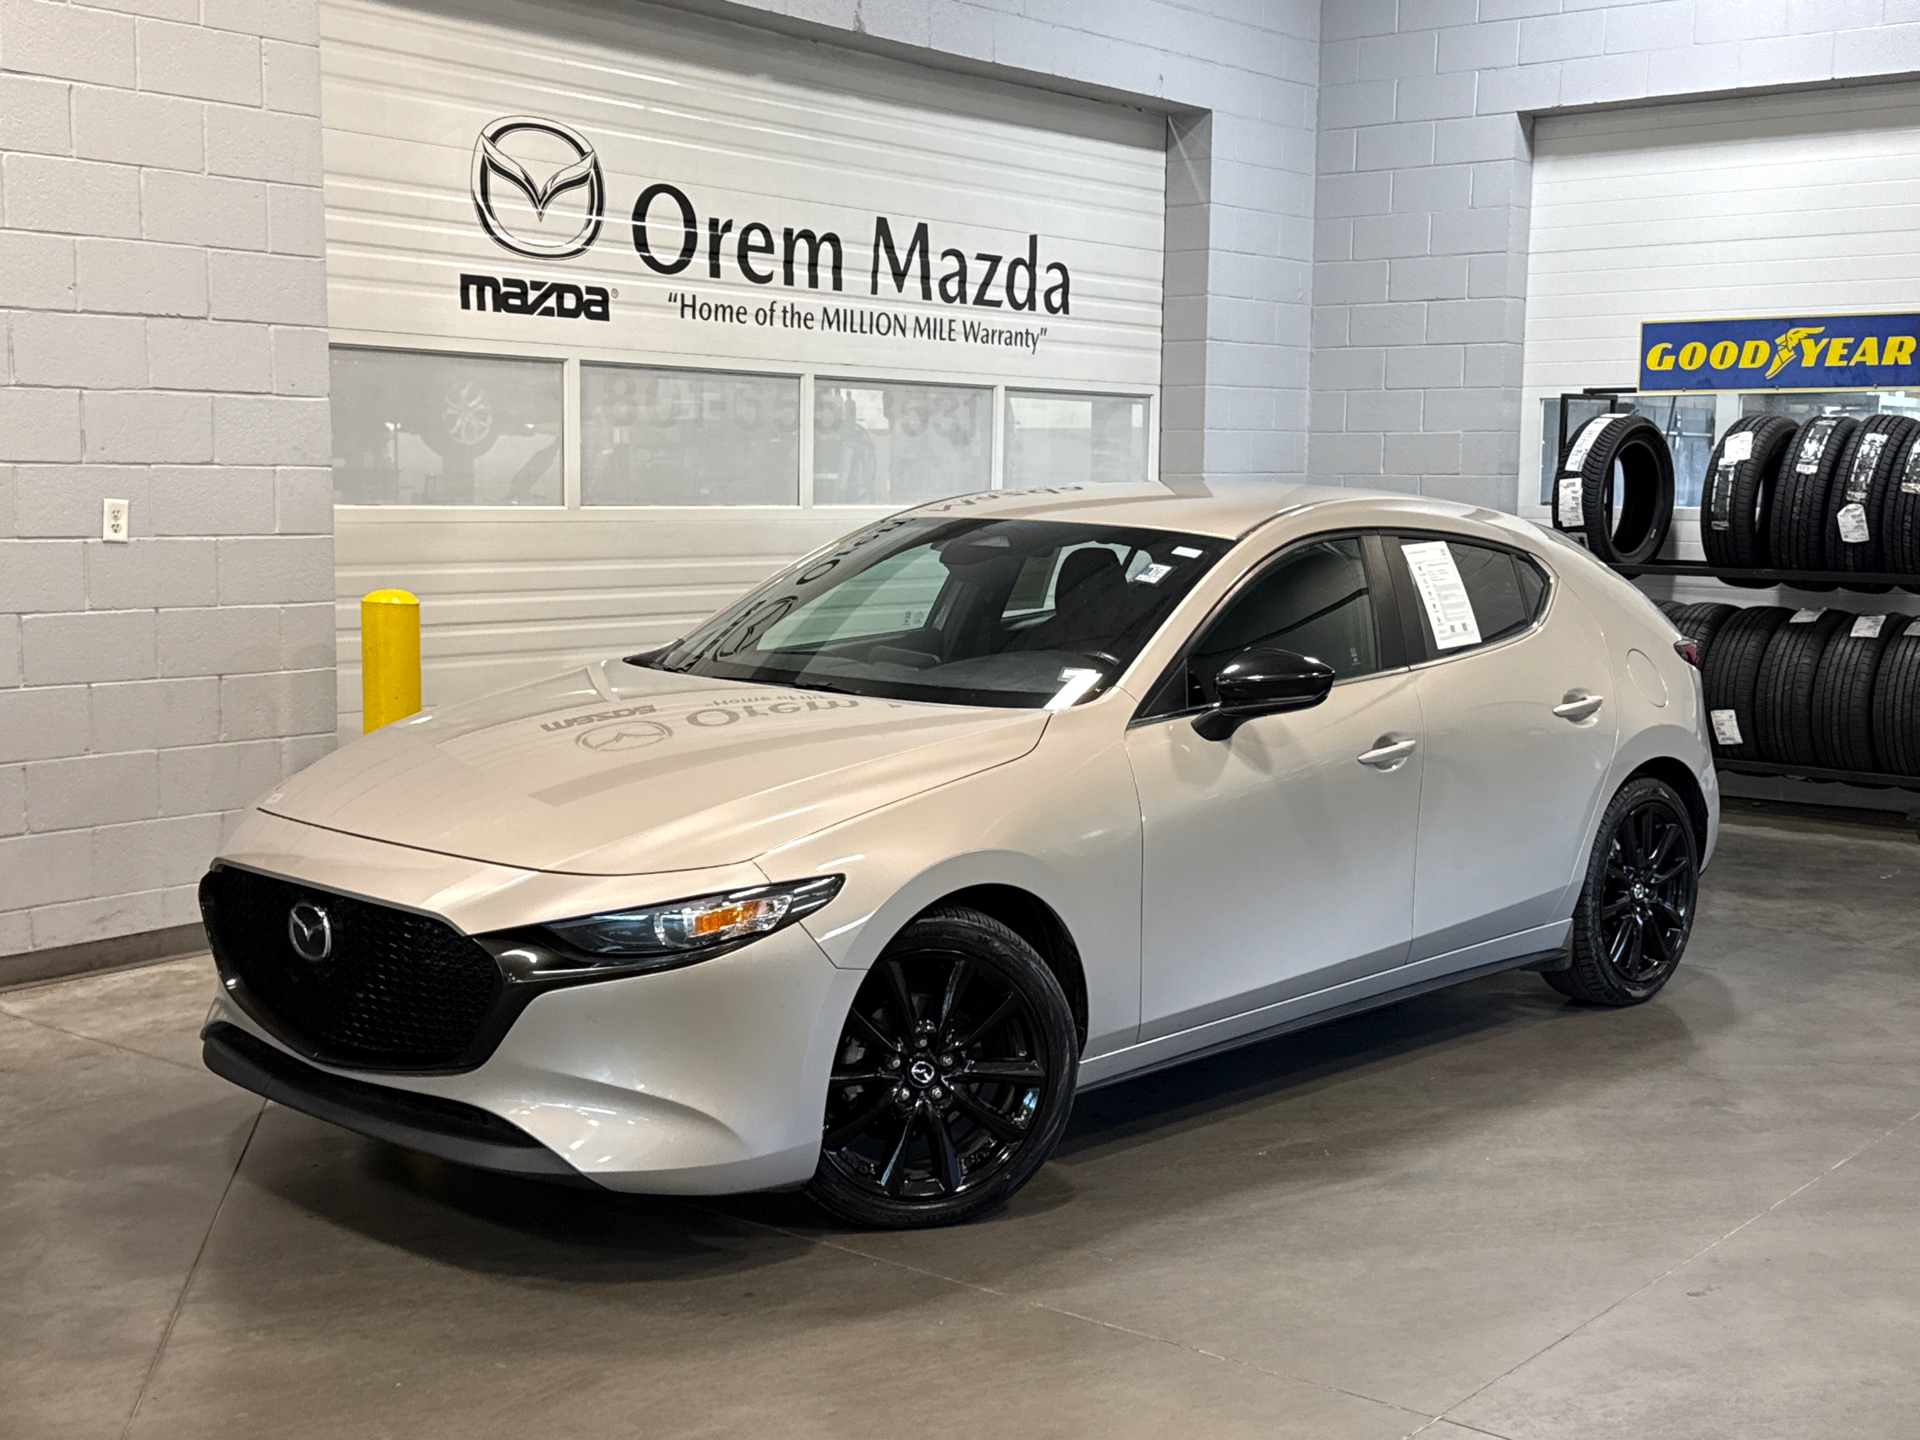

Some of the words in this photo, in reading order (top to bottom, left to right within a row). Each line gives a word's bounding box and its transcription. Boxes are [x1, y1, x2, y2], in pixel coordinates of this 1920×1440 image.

[631, 183, 843, 292] Orem
[869, 216, 1070, 316] Mazda
[668, 292, 748, 327] “Home
[754, 300, 777, 327] of
[782, 302, 815, 330] the
[820, 306, 907, 339] MILLION
[912, 316, 957, 342] MILE
